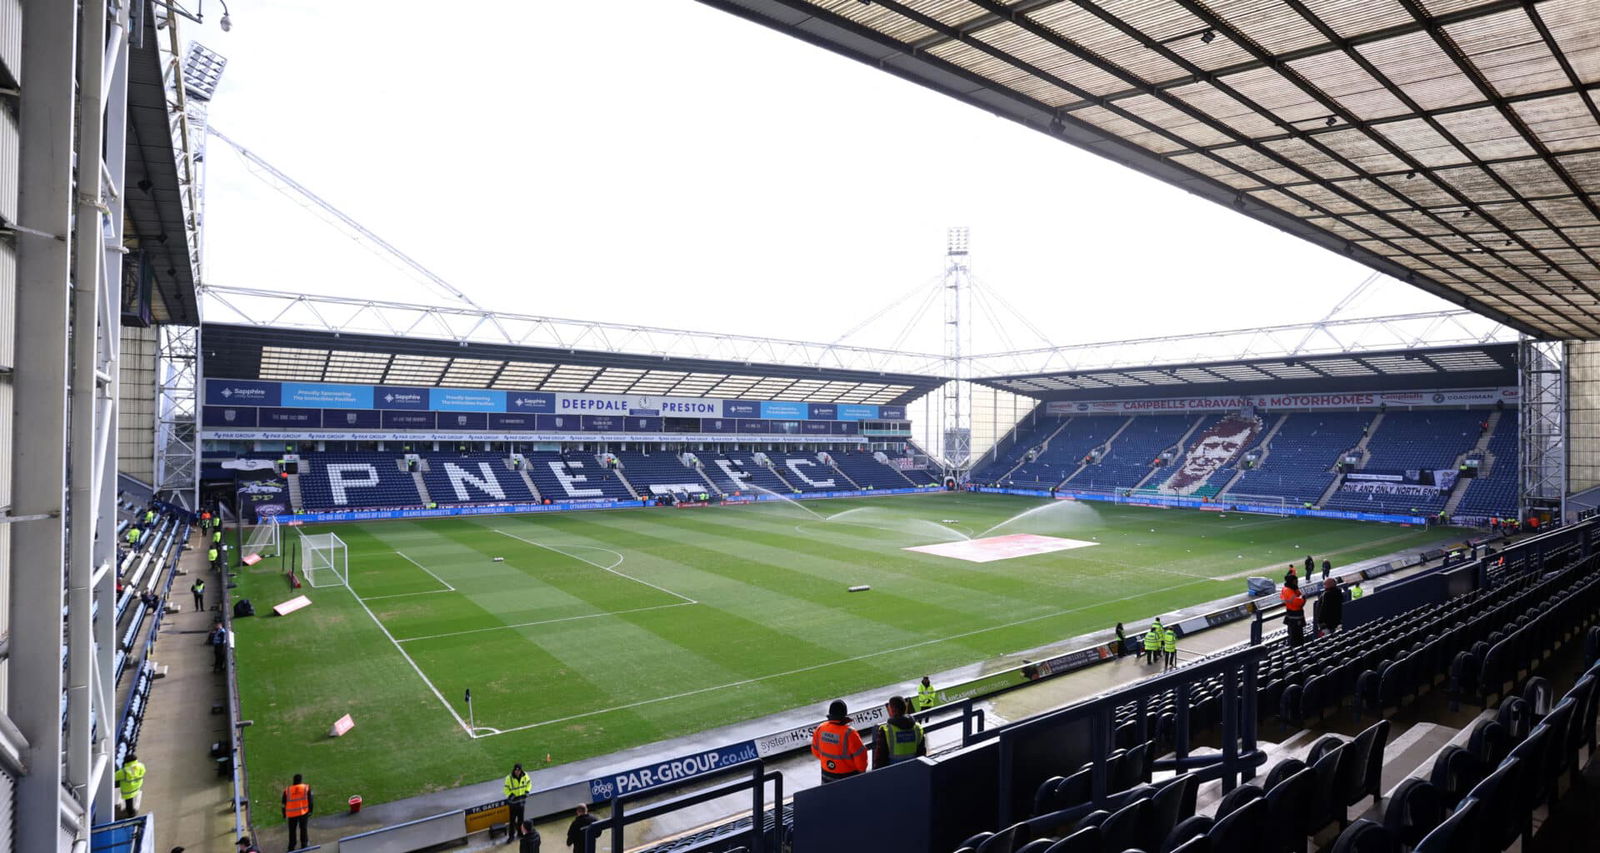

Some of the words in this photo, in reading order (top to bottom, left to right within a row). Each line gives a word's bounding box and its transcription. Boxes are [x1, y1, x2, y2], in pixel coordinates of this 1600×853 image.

[562, 398, 628, 410] DEEPDALE
[662, 402, 714, 413] PRESTON
[1123, 400, 1186, 410] CAMPBELLS
[1258, 398, 1266, 406] &
[1270, 394, 1374, 406] MOTORHOMES
[1375, 485, 1395, 494] ONLY
[1396, 487, 1420, 495] NORTH
[1422, 488, 1438, 496] END
[615, 746, 757, 794] PAR-GROUP.co.uk
